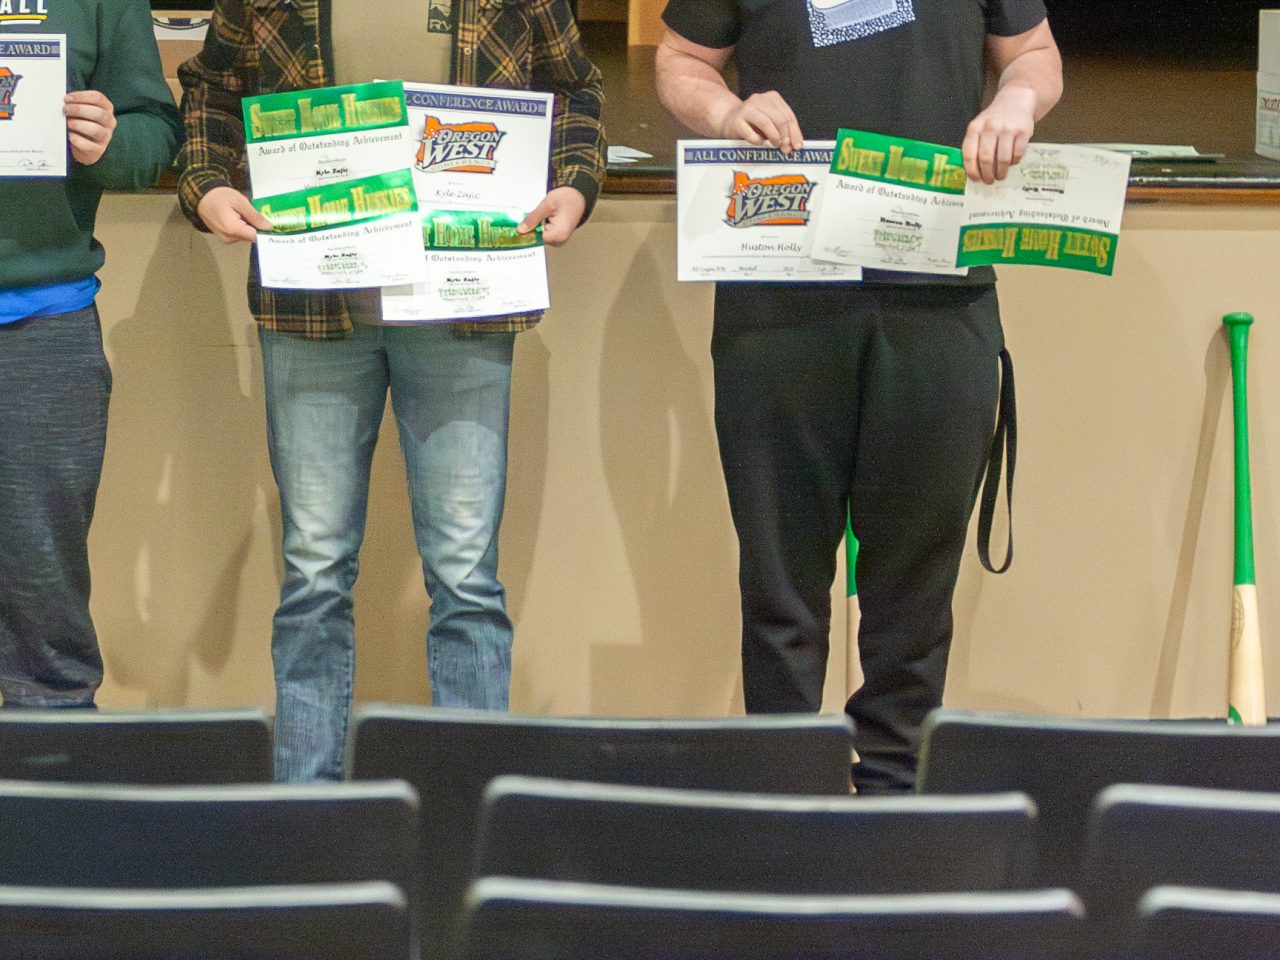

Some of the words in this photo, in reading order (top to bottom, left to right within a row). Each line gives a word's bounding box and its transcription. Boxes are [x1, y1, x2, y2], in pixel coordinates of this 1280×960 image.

[8, 44, 51, 55] AWARD
[412, 94, 494, 109] CONFERENCE
[495, 100, 538, 114] AWARD
[438, 129, 502, 144] OREGON
[258, 145, 286, 157] Award
[288, 143, 297, 152] of
[299, 139, 350, 152] Outstanding
[352, 133, 403, 146] Achievement
[421, 139, 497, 169] WEST
[695, 152, 718, 161] ALL
[720, 150, 801, 162] CONFERENCE
[748, 183, 813, 198] OREGON
[836, 180, 863, 192] Award
[866, 184, 875, 194] of
[878, 187, 928, 205] Outstanding
[732, 193, 806, 225] WEST
[1071, 215, 1079, 223] of
[1083, 216, 1110, 228] Award
[363, 221, 413, 234] Achievement
[741, 243, 774, 251] Huston
[777, 243, 802, 252] Holly
[431, 254, 482, 263] Outstanding
[486, 251, 536, 262] Achievement
